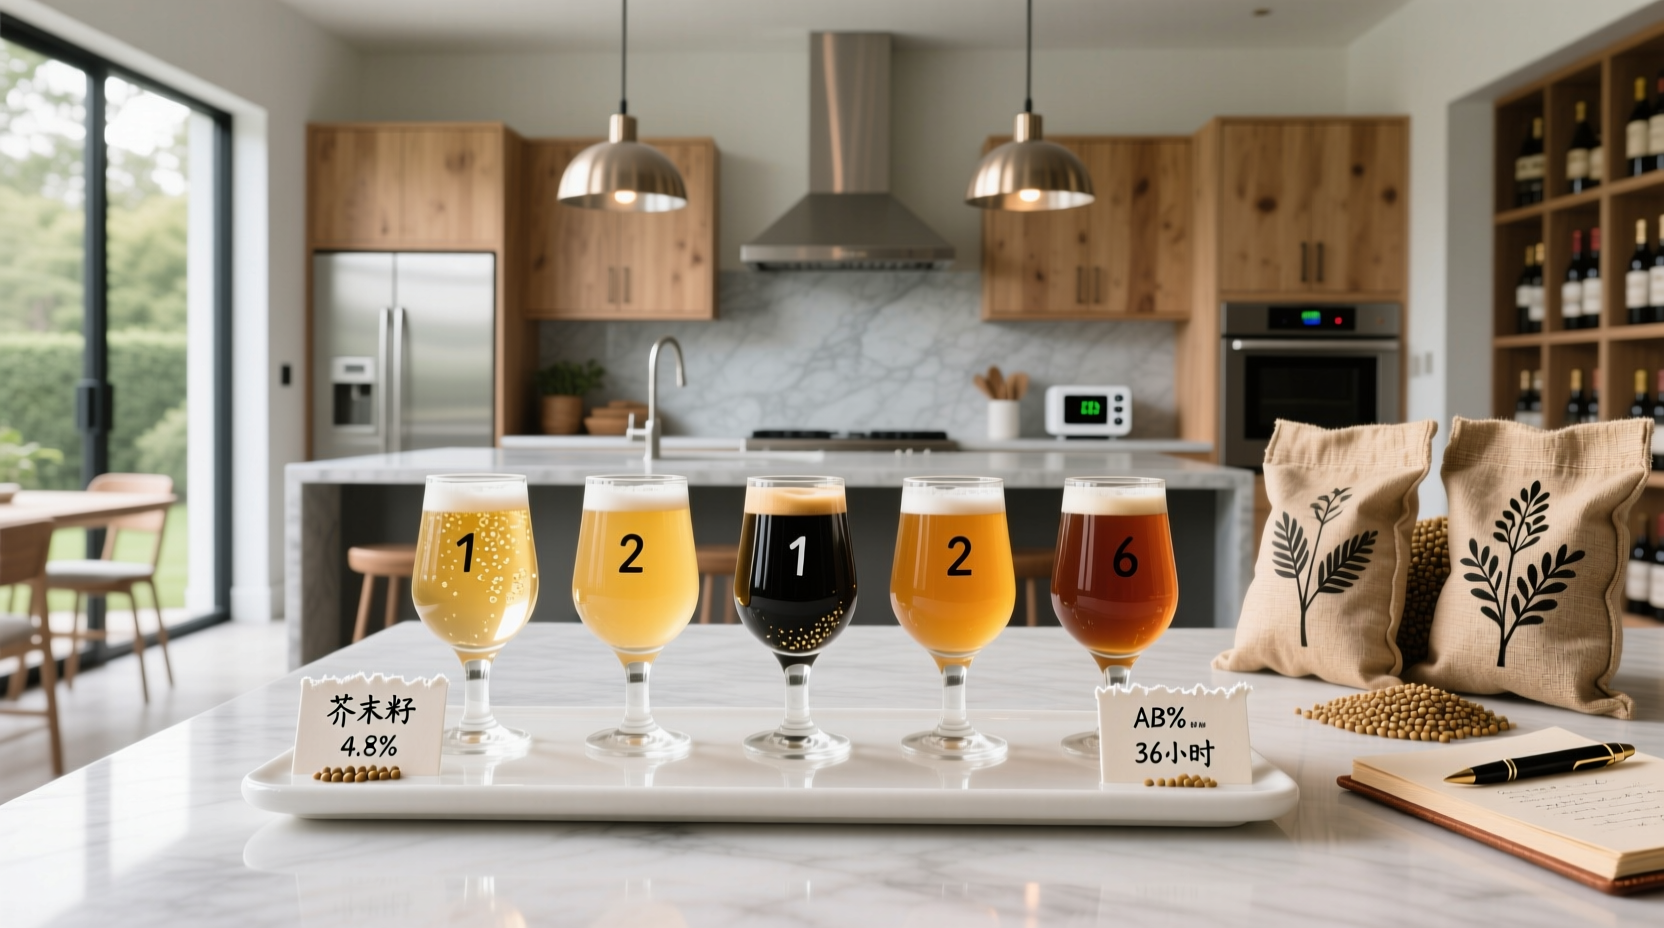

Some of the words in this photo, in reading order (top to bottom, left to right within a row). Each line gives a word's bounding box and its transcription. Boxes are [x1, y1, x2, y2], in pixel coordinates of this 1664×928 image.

[456, 532, 475, 573] 1
[618, 533, 645, 574] 2
[789, 535, 807, 577] 1
[946, 535, 973, 577] 2
[1112, 535, 1139, 578] 6
[326, 693, 417, 728] 芥末籽
[1133, 706, 1187, 729] AB%
[340, 734, 398, 758] 4.8%
[1134, 739, 1215, 768] 36小时
